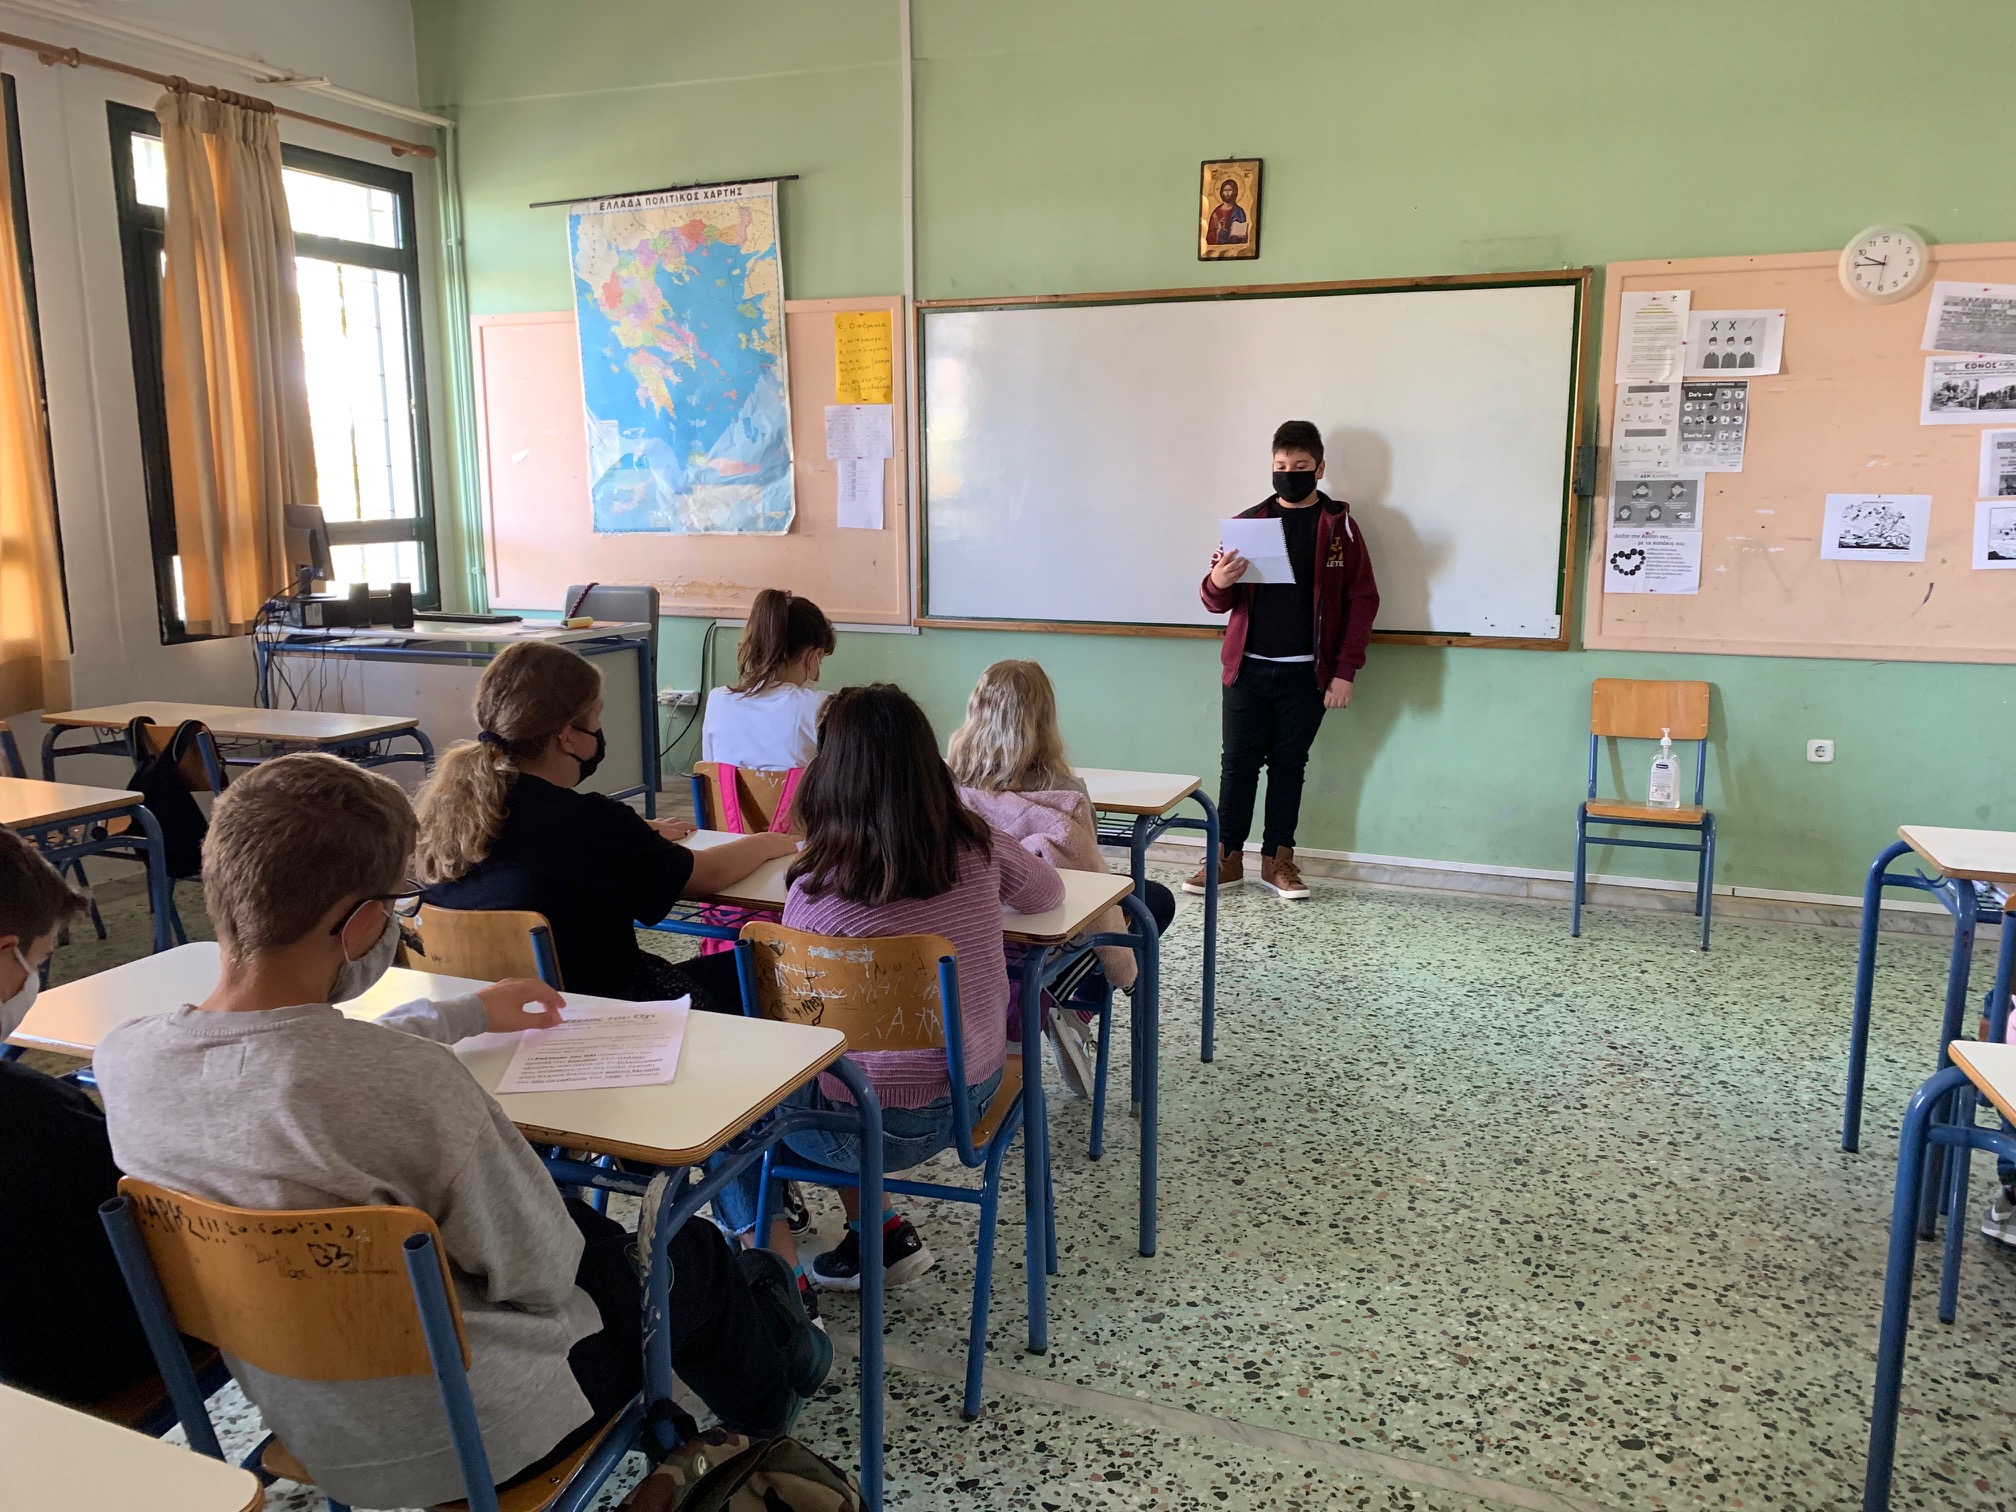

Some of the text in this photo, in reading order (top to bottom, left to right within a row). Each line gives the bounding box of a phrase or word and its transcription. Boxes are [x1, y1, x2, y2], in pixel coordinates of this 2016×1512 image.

[600, 187, 742, 210] ΕΛΛΑΔΑ ΠΟΛΙΤΙΚΟΣ ΧΑΡΤΗΣ
